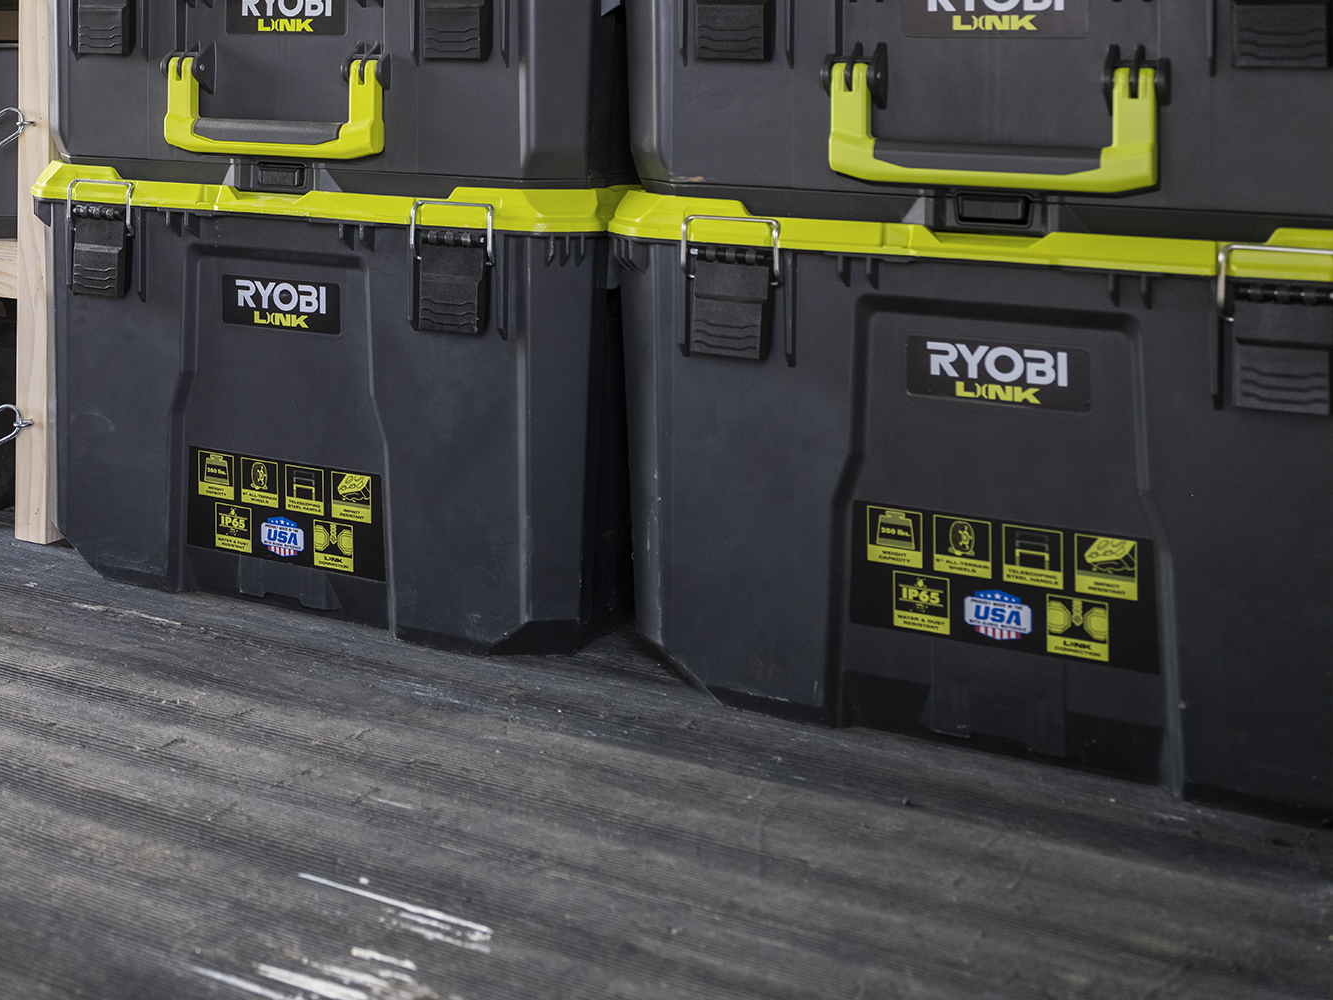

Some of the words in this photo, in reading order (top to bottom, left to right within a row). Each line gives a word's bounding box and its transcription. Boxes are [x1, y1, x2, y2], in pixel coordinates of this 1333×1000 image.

[235, 279, 327, 315] RYOBI
[926, 341, 1068, 387] RYOBI
[220, 515, 246, 529] IP65
[267, 528, 298, 546] USA
[881, 527, 896, 535] 200
[897, 529, 911, 538] lbs.
[878, 554, 911, 563] CAPACITY
[881, 549, 907, 557] WEIGHT
[945, 559, 990, 570] ALL-TERRAIN
[948, 565, 977, 573] WHEELS
[1006, 573, 1028, 582] STEEL
[1030, 576, 1059, 586] HANDLE
[1008, 567, 1058, 580] TELESCOPING
[1088, 585, 1126, 596] RESISTANT
[1093, 581, 1120, 589] IMPACT
[901, 586, 941, 604] IP65
[897, 613, 920, 622] WATER
[927, 617, 945, 626] DUST
[974, 604, 1021, 626] USA
[903, 620, 939, 630] RESISTANT
[1054, 645, 1102, 658] CONNECTION
